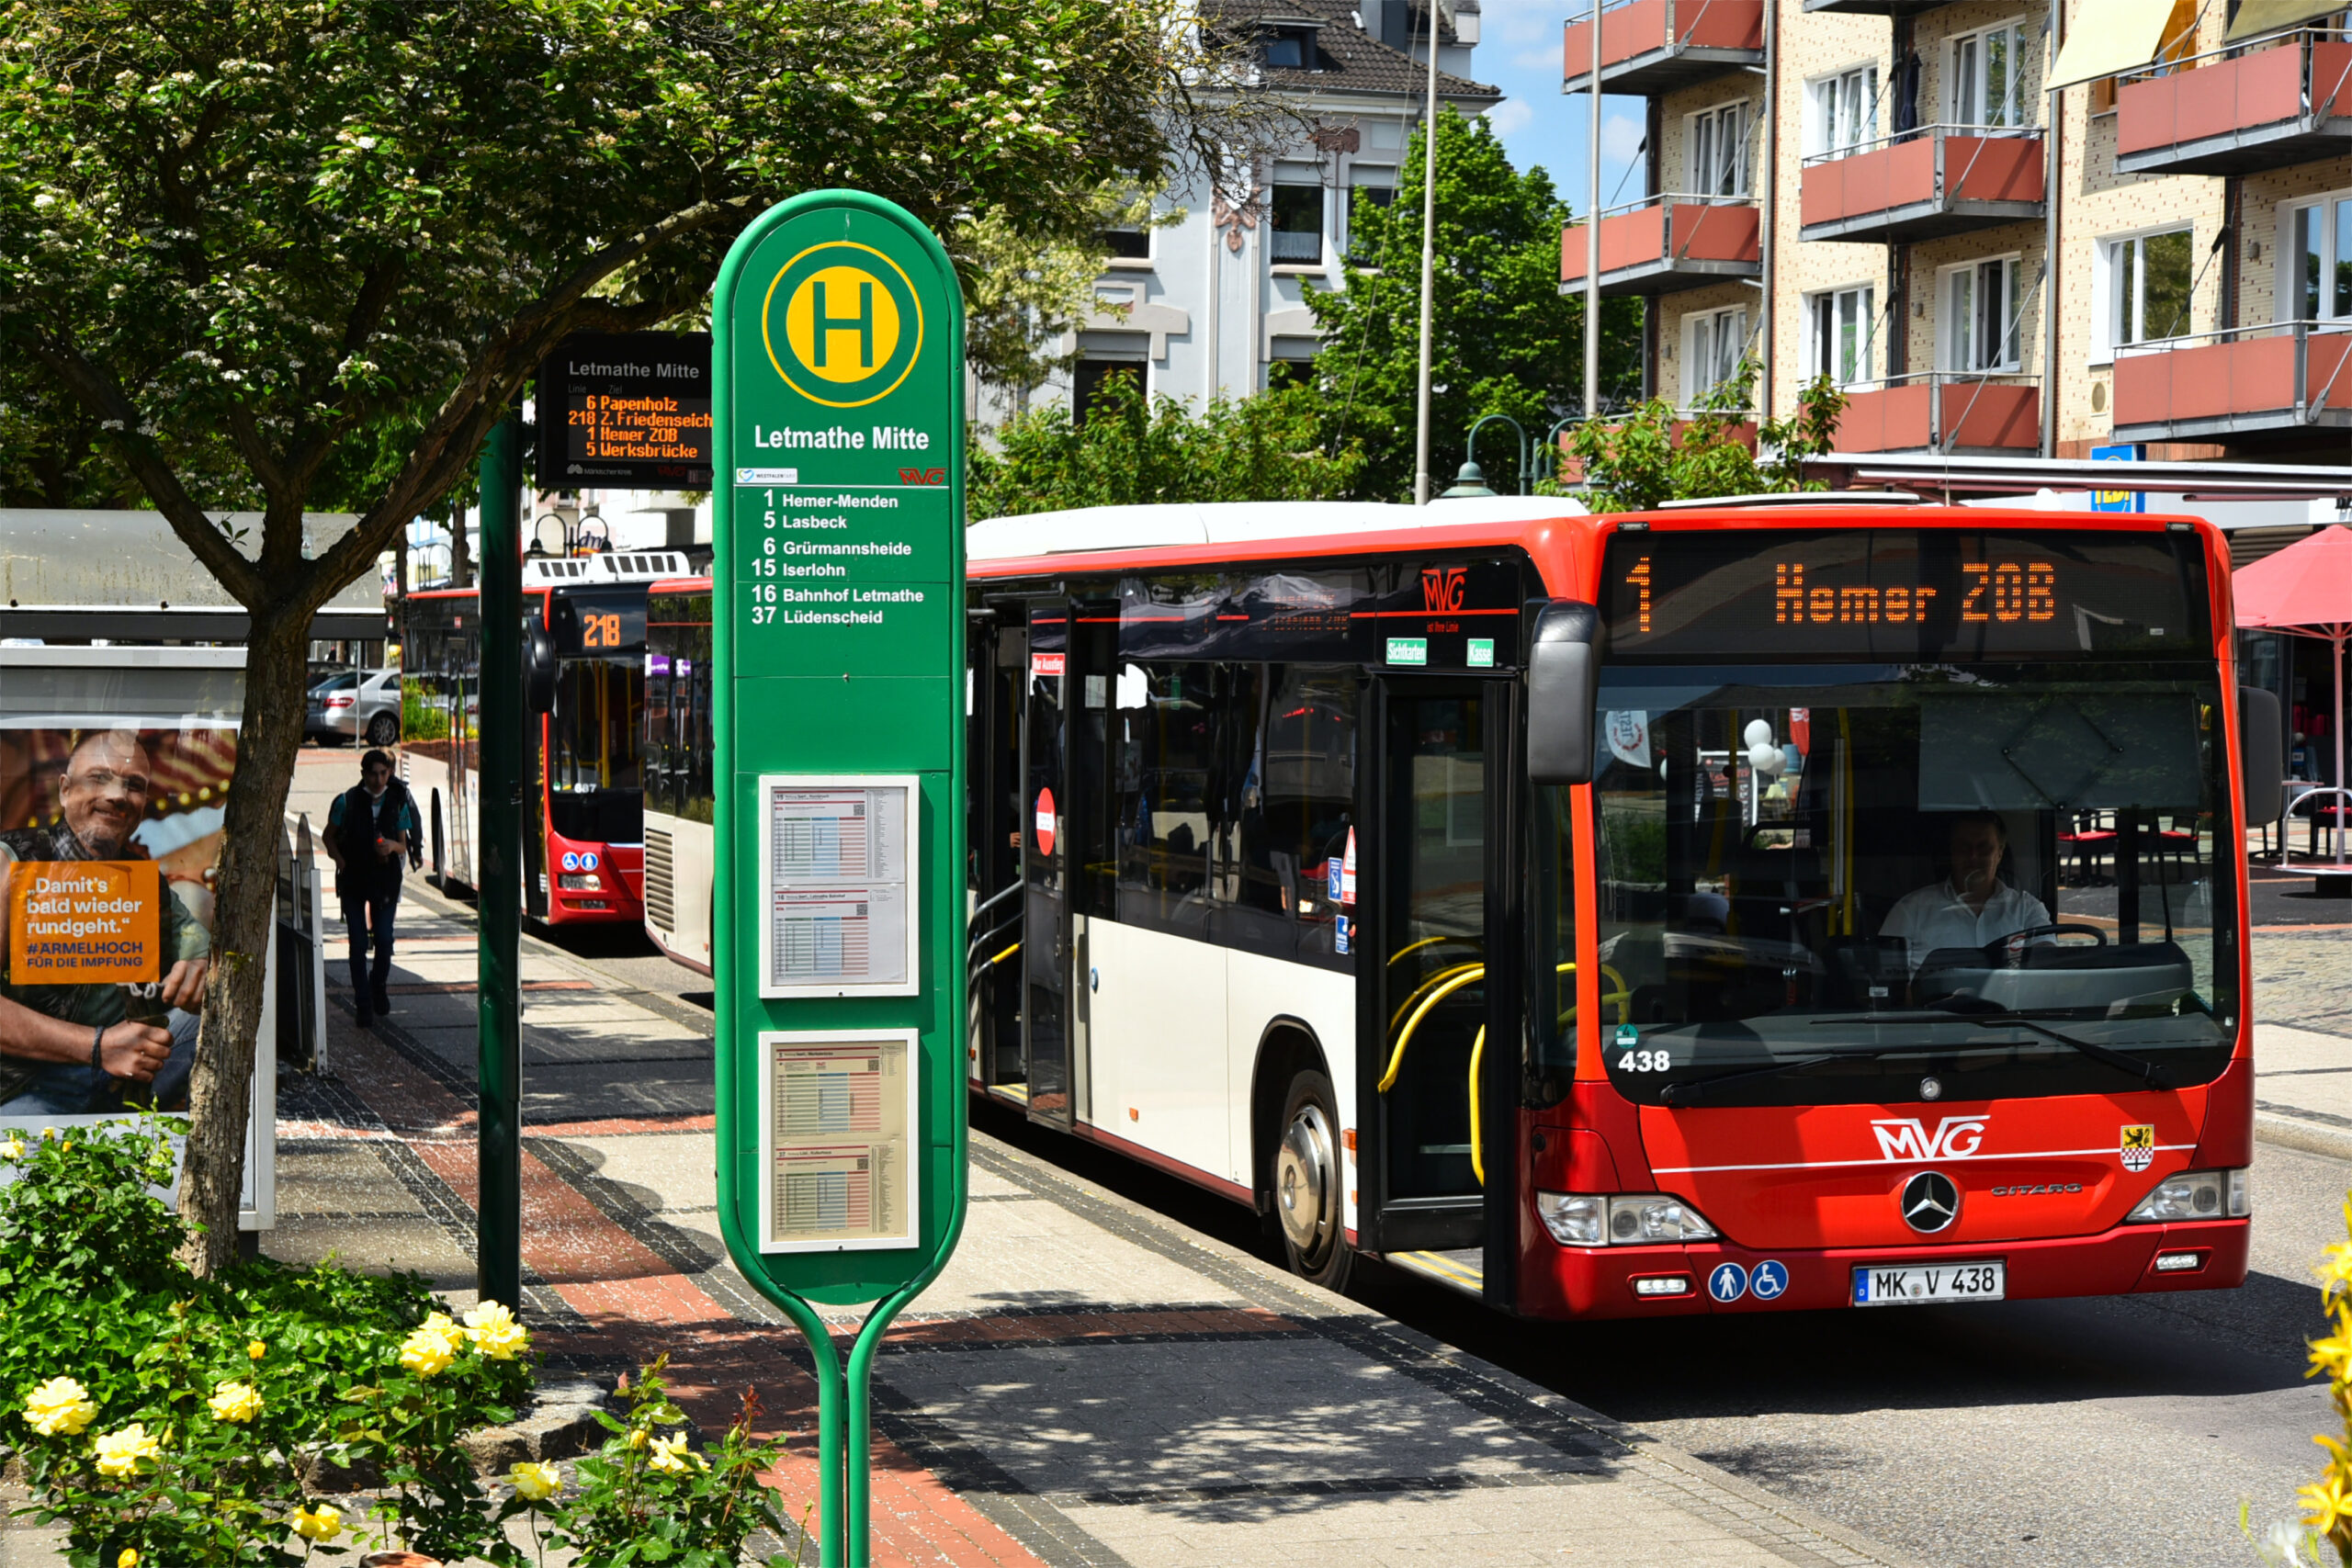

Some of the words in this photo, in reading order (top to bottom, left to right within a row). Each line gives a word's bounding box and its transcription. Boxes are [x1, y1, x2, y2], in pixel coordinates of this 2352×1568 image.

[812, 281, 873, 367] H
[569, 361, 650, 377] Letmathe
[657, 363, 700, 378] Mitte
[568, 384, 587, 393] Linie
[608, 385, 622, 394] Ziel
[586, 395, 596, 411] 6
[600, 395, 678, 412] Papenholz
[568, 411, 596, 425] 218
[600, 411, 614, 426] Z.
[616, 412, 713, 427] Friedenseich
[586, 426, 595, 441] 1
[600, 426, 646, 442] Hemer
[649, 427, 678, 443] ZOB
[754, 424, 865, 449] Letmathe
[873, 425, 930, 450] Mitte
[586, 442, 596, 457] 5
[600, 442, 698, 458] Werksbrücke
[898, 468, 947, 485] MVG
[763, 489, 774, 507] 1
[783, 494, 899, 508] Hemer-Menden
[763, 511, 776, 529] 5
[783, 515, 847, 529] Lasbeck
[763, 537, 776, 556] 6
[783, 542, 912, 556] Grürmannsheide
[752, 558, 776, 577] 15
[783, 563, 845, 577] Iserlohn
[752, 584, 777, 603] 16
[783, 589, 849, 603] Bahnhof
[853, 589, 924, 603] Letmathe
[1421, 568, 1468, 612] MVG
[1626, 557, 1650, 632] 1
[1776, 563, 1937, 624] Hemer
[1962, 562, 2054, 623] ZOB
[752, 606, 777, 625] 37
[785, 610, 884, 624] Lüdenscheid
[583, 615, 620, 647] 218
[1387, 642, 1425, 661] Sichtkarten
[1469, 644, 1492, 662] Kasse
[27, 898, 70, 914] bald
[73, 897, 142, 914] wieder
[27, 941, 143, 955] #ÄRMELHOCH
[28, 956, 52, 968] FÜR
[56, 957, 77, 968] DIE
[81, 956, 143, 967] IMPFUNG
[1618, 1050, 1670, 1072] 438
[1870, 1115, 1992, 1161] MVG
[1991, 1183, 2083, 1197] CITARO
[1876, 1271, 1906, 1298] MK
[1926, 1270, 1940, 1294] V
[1951, 1267, 1996, 1293] 438
